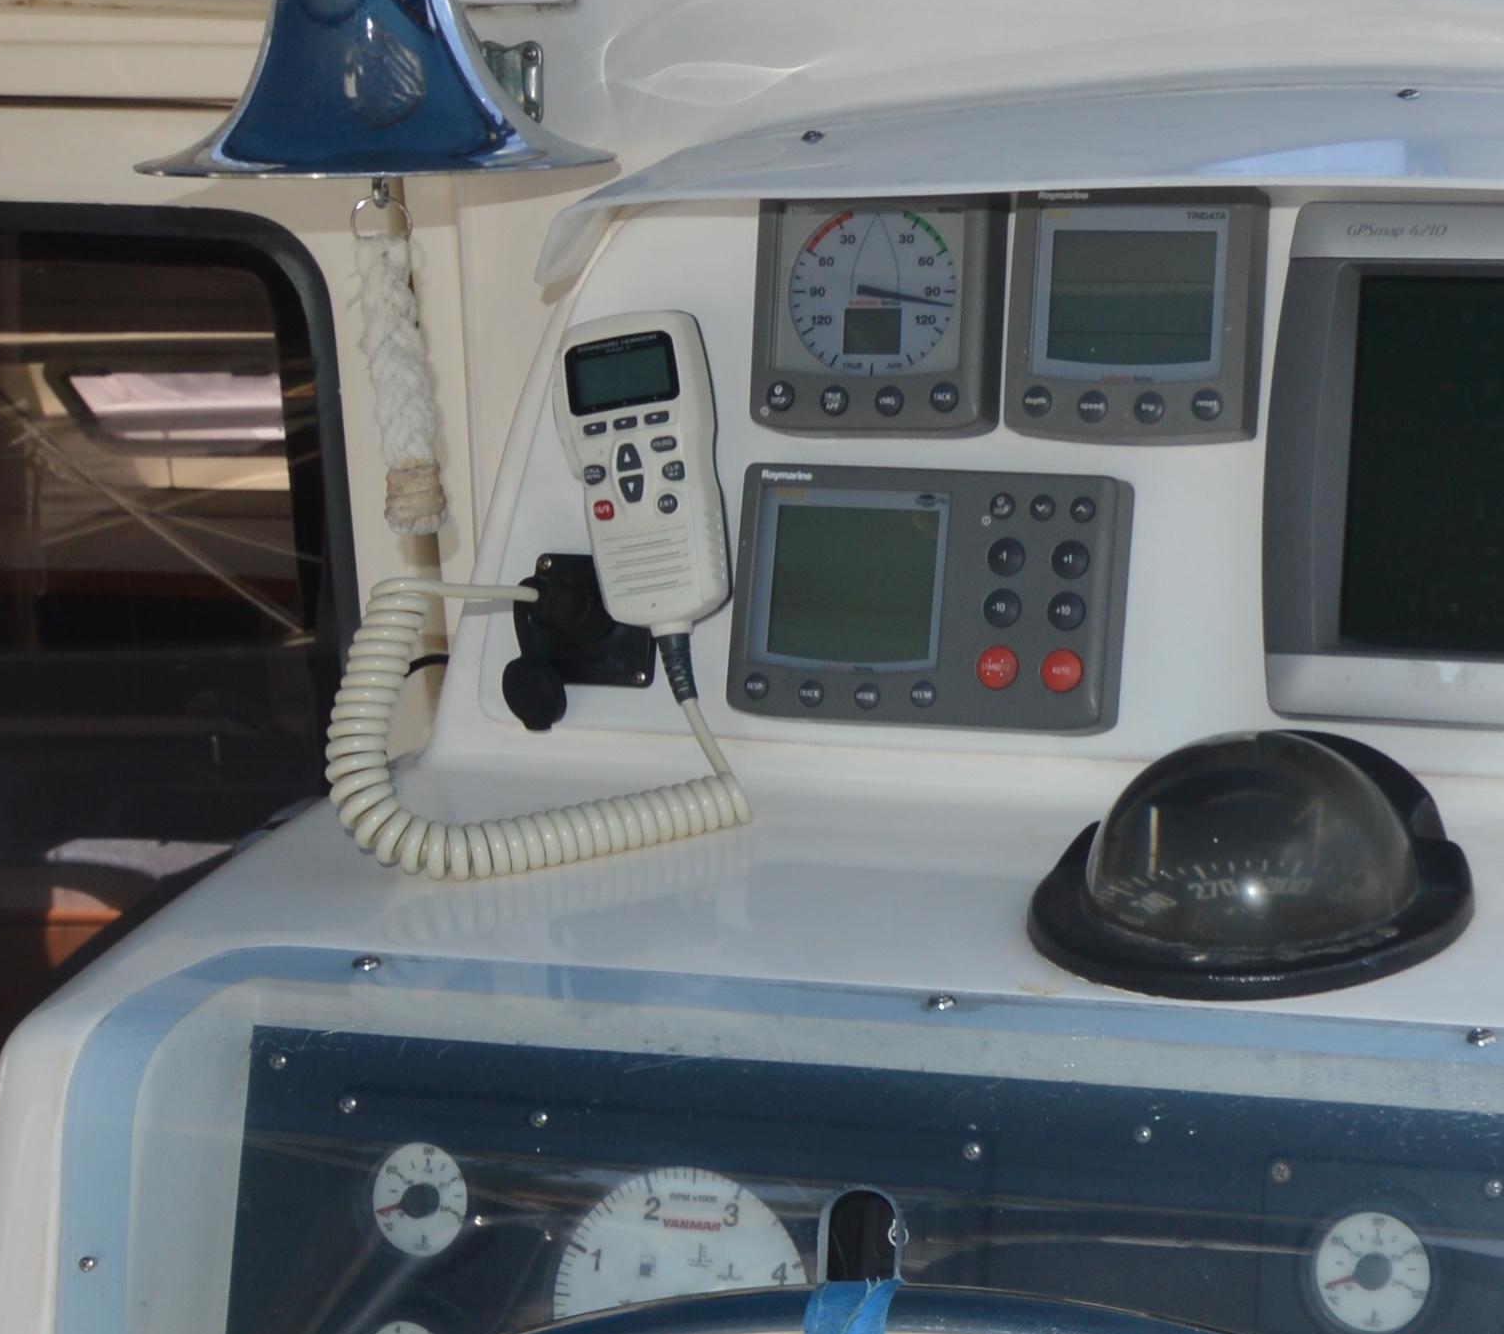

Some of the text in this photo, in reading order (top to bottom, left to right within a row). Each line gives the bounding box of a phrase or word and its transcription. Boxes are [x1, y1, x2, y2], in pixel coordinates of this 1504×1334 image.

[1037, 190, 1089, 201] Raymarine
[1186, 211, 1227, 220] TRIDATA
[1409, 223, 1448, 237] 4210
[839, 234, 856, 245] 30
[898, 234, 915, 245] 30
[818, 256, 835, 267] 60
[918, 256, 934, 267] 60
[809, 286, 826, 297] 90
[924, 286, 941, 297] 90
[811, 315, 833, 326] 120
[914, 315, 936, 326] 120
[1080, 401, 1105, 413] speed
[1195, 399, 1218, 408] reset
[761, 469, 814, 482] Raymarine
[999, 551, 1007, 561] -1
[1063, 554, 1073, 564] +1
[992, 602, 1006, 613] -10
[1056, 606, 1071, 616] +10
[1051, 666, 1071, 675] AUTO
[1188, 878, 1239, 901] 270
[669, 1192, 691, 1202] RPM
[643, 1196, 662, 1221] 2
[722, 1202, 740, 1228] 3
[662, 1218, 723, 1233] YANMAR
[590, 1248, 603, 1272] 1
[771, 1261, 788, 1285] 4
